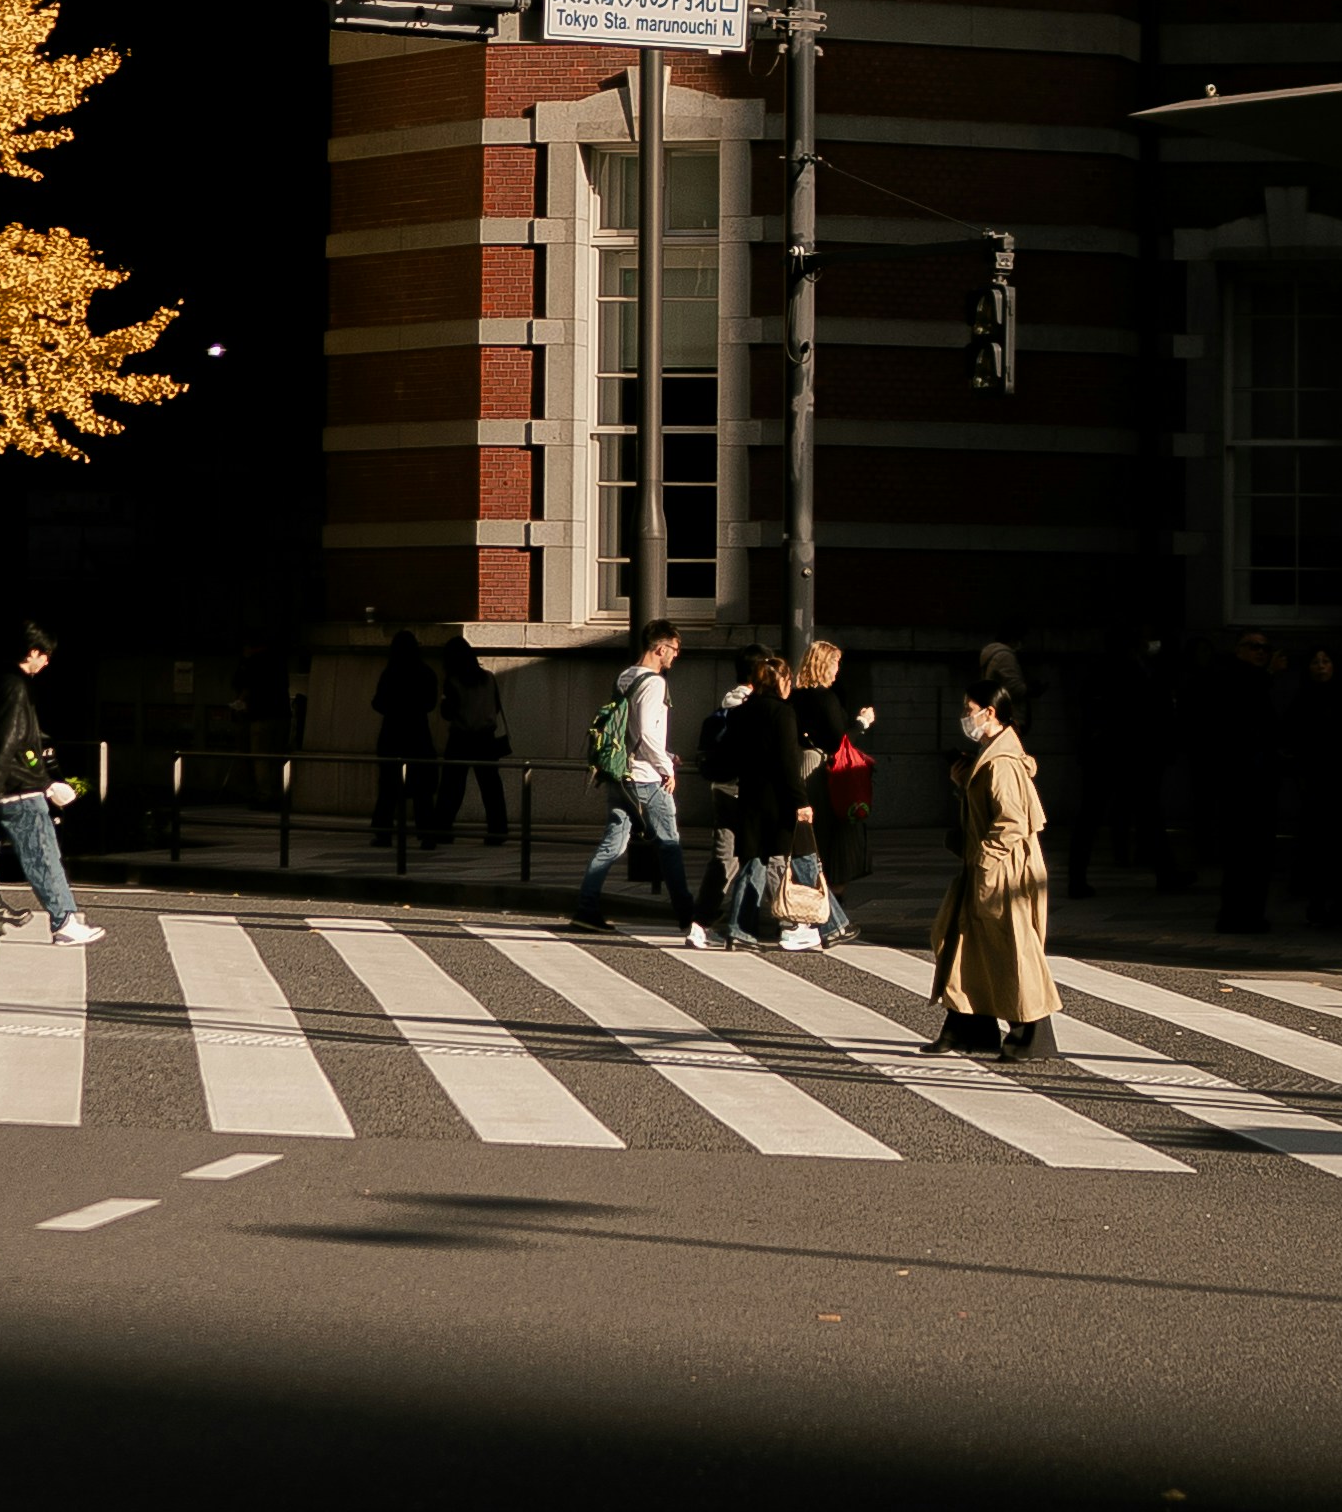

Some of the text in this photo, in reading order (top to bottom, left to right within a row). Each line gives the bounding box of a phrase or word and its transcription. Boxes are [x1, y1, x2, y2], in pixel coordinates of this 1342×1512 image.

[557, 9, 735, 36] Tokyo Sta. marunouchi N.
